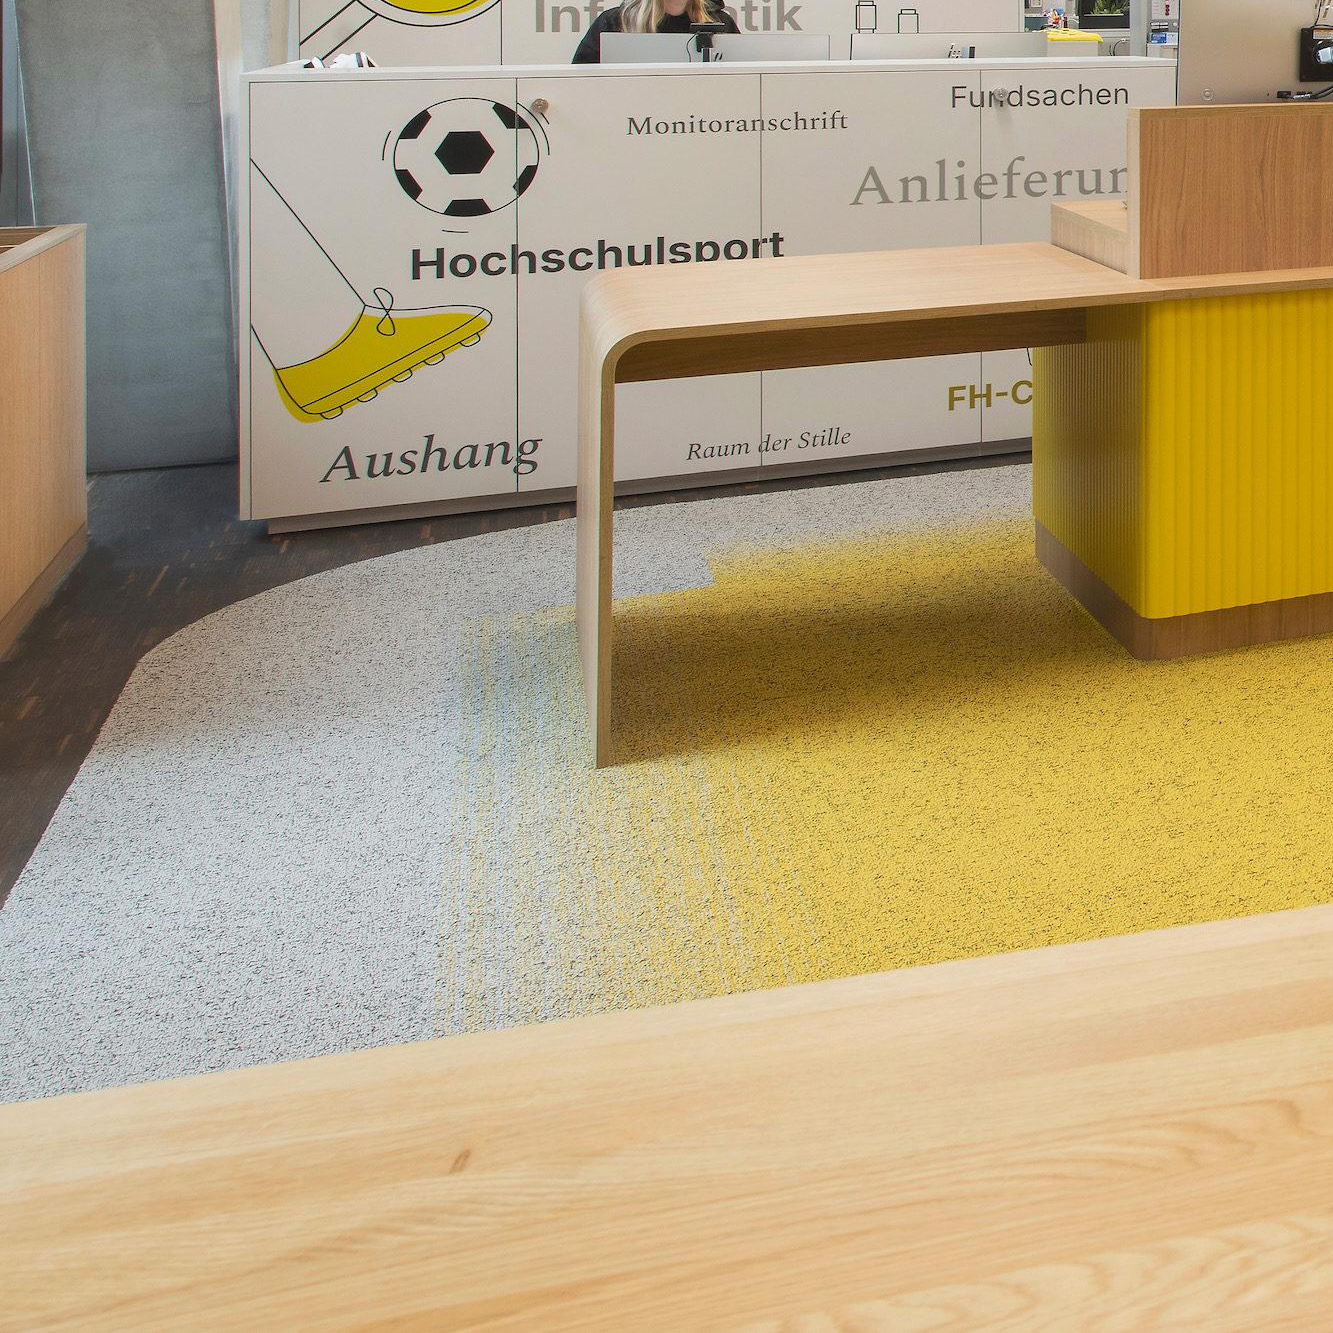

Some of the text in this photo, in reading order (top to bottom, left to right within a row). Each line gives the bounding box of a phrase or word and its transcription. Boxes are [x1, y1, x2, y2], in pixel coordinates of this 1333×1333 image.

[626, 110, 849, 136] Monitoranschrift
[411, 231, 785, 281] Hochschulsport
[318, 432, 543, 484] Aushang
[685, 426, 852, 462] Raum der Stille
